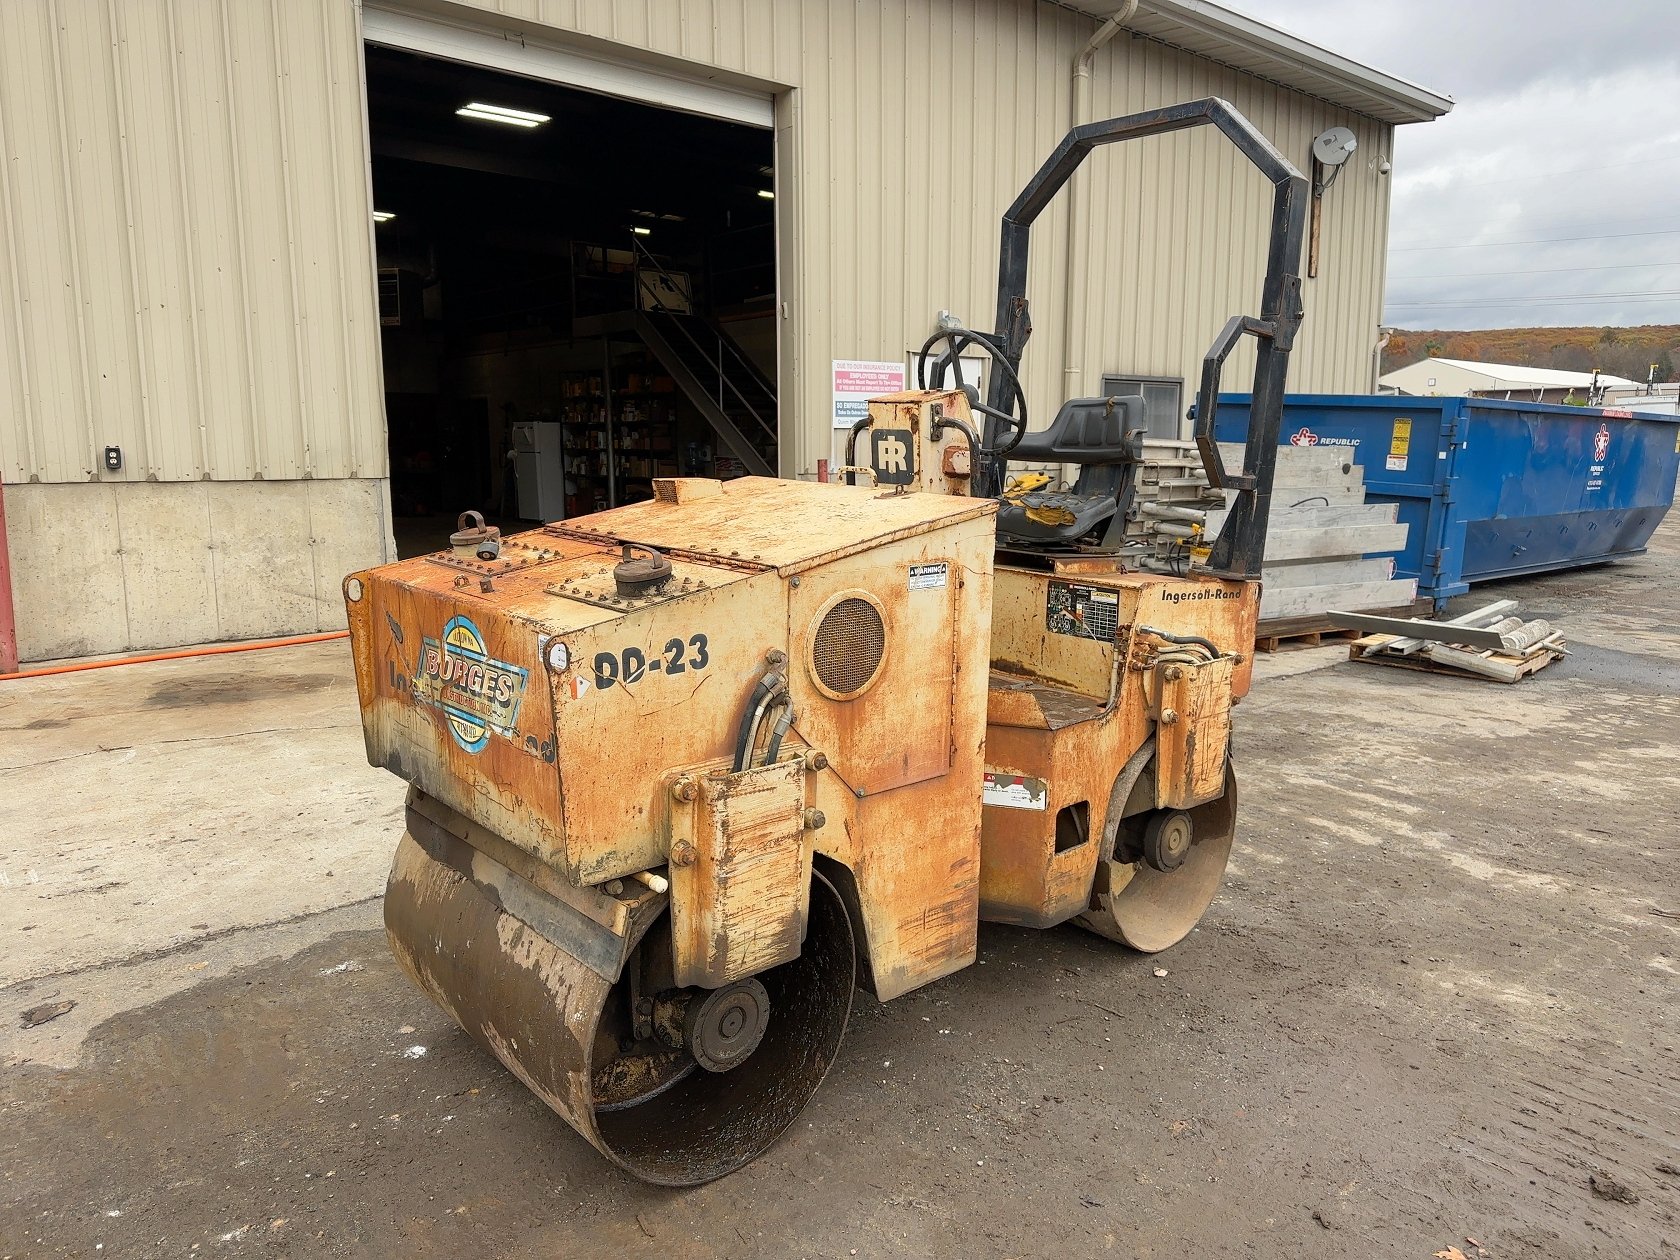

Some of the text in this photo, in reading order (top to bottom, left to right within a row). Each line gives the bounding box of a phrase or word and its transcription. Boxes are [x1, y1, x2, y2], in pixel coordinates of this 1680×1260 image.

[849, 372, 877, 380] EMPLOYEES
[1320, 437, 1361, 446] REPUBLIC
[1161, 588, 1242, 605] Ingersoll-Rand
[594, 633, 709, 690] DD-23
[425, 649, 515, 706] BORGES
[442, 689, 481, 711] NSTRUCTION
